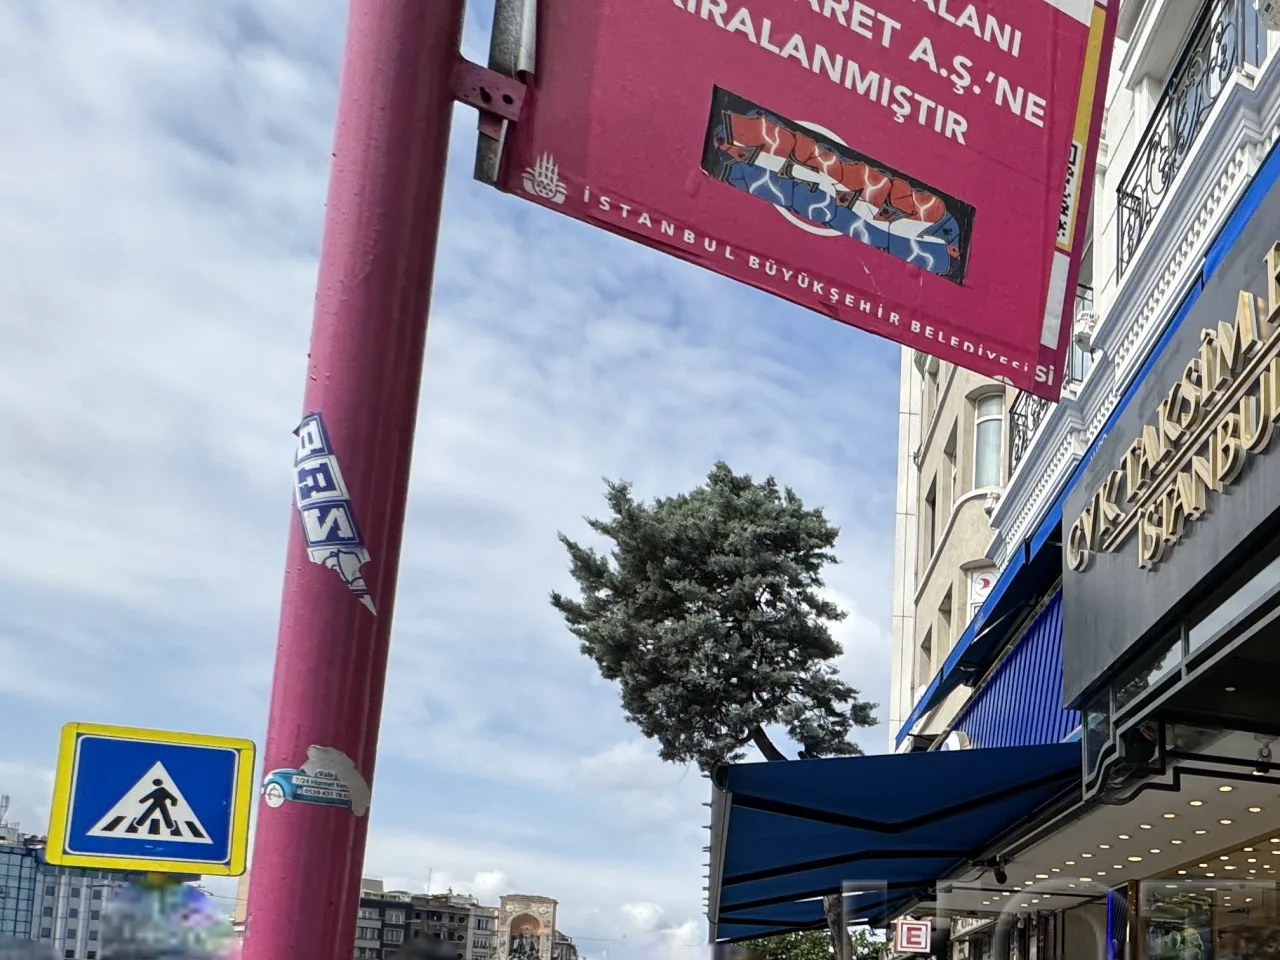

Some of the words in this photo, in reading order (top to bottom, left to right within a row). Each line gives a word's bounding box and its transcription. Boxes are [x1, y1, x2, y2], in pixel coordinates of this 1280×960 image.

[672, 0, 969, 146] RALANMIŞTIR
[748, 254, 901, 327] BÜYÜKŞEHİR
[1066, 469, 1127, 573] CVK
[905, 926, 923, 946] E
